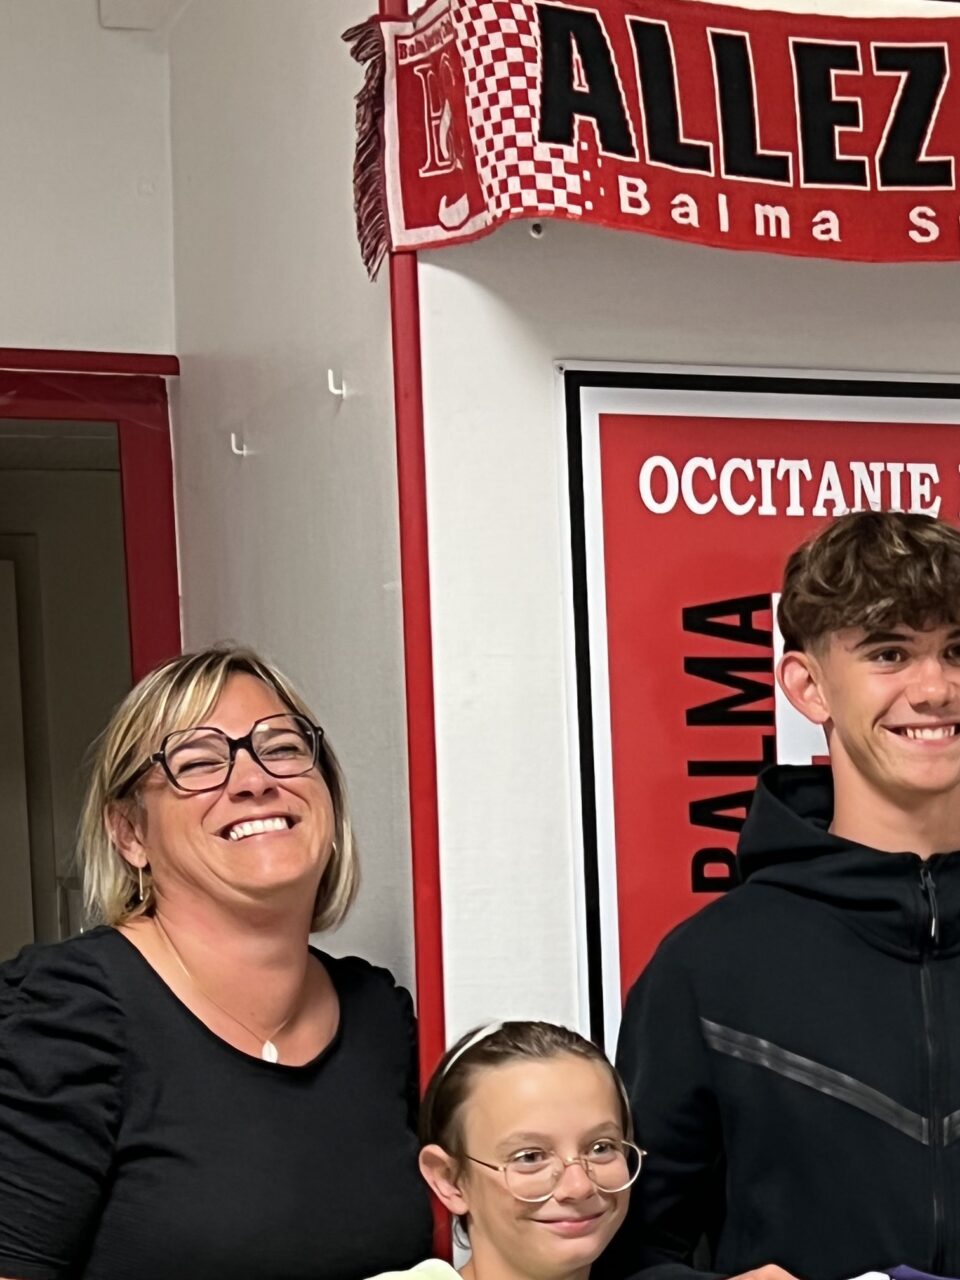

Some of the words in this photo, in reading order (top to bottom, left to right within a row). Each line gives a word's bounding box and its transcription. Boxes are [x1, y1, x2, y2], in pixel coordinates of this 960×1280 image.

[533, 2, 956, 191] ALLEZ
[617, 175, 842, 242] Balma
[639, 455, 942, 518] OCCITANIE
